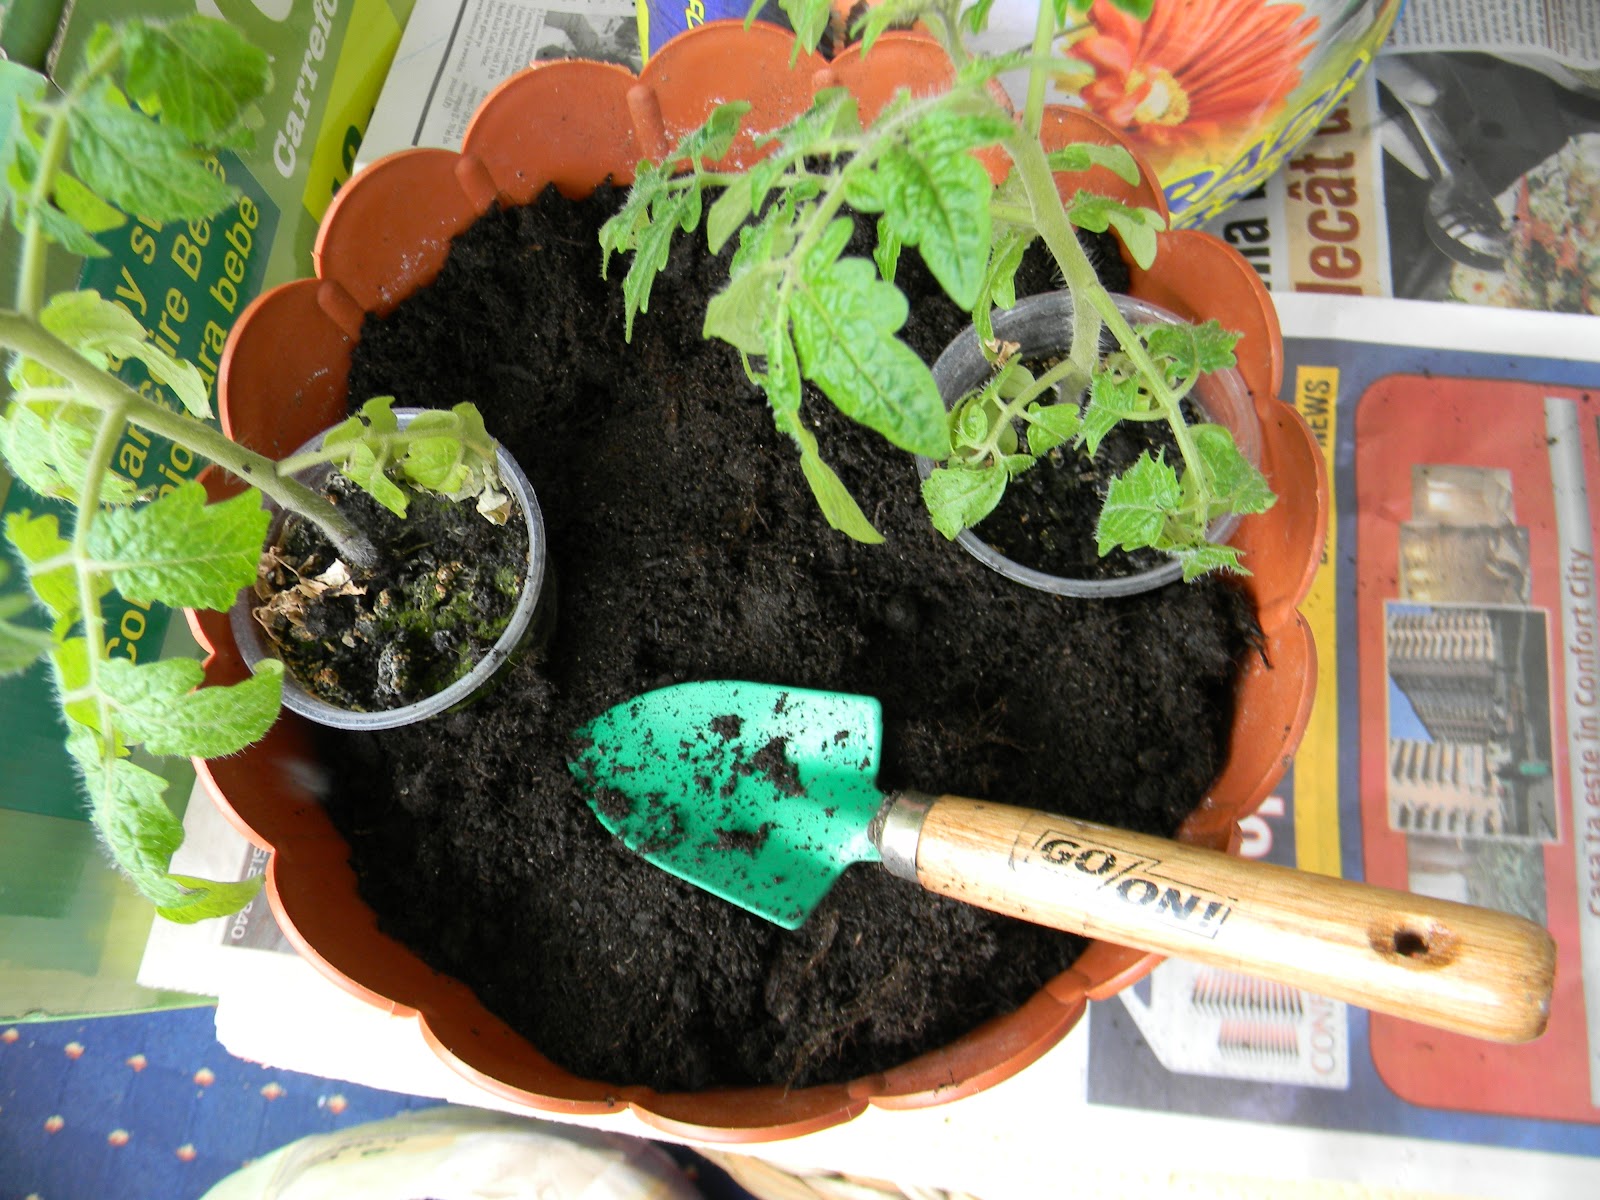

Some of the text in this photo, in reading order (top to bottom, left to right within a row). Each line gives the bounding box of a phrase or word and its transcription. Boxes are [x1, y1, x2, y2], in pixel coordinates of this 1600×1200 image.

[209, 195, 259, 314] bebe
[1566, 546, 1592, 598] City
[1570, 607, 1596, 707] Confort
